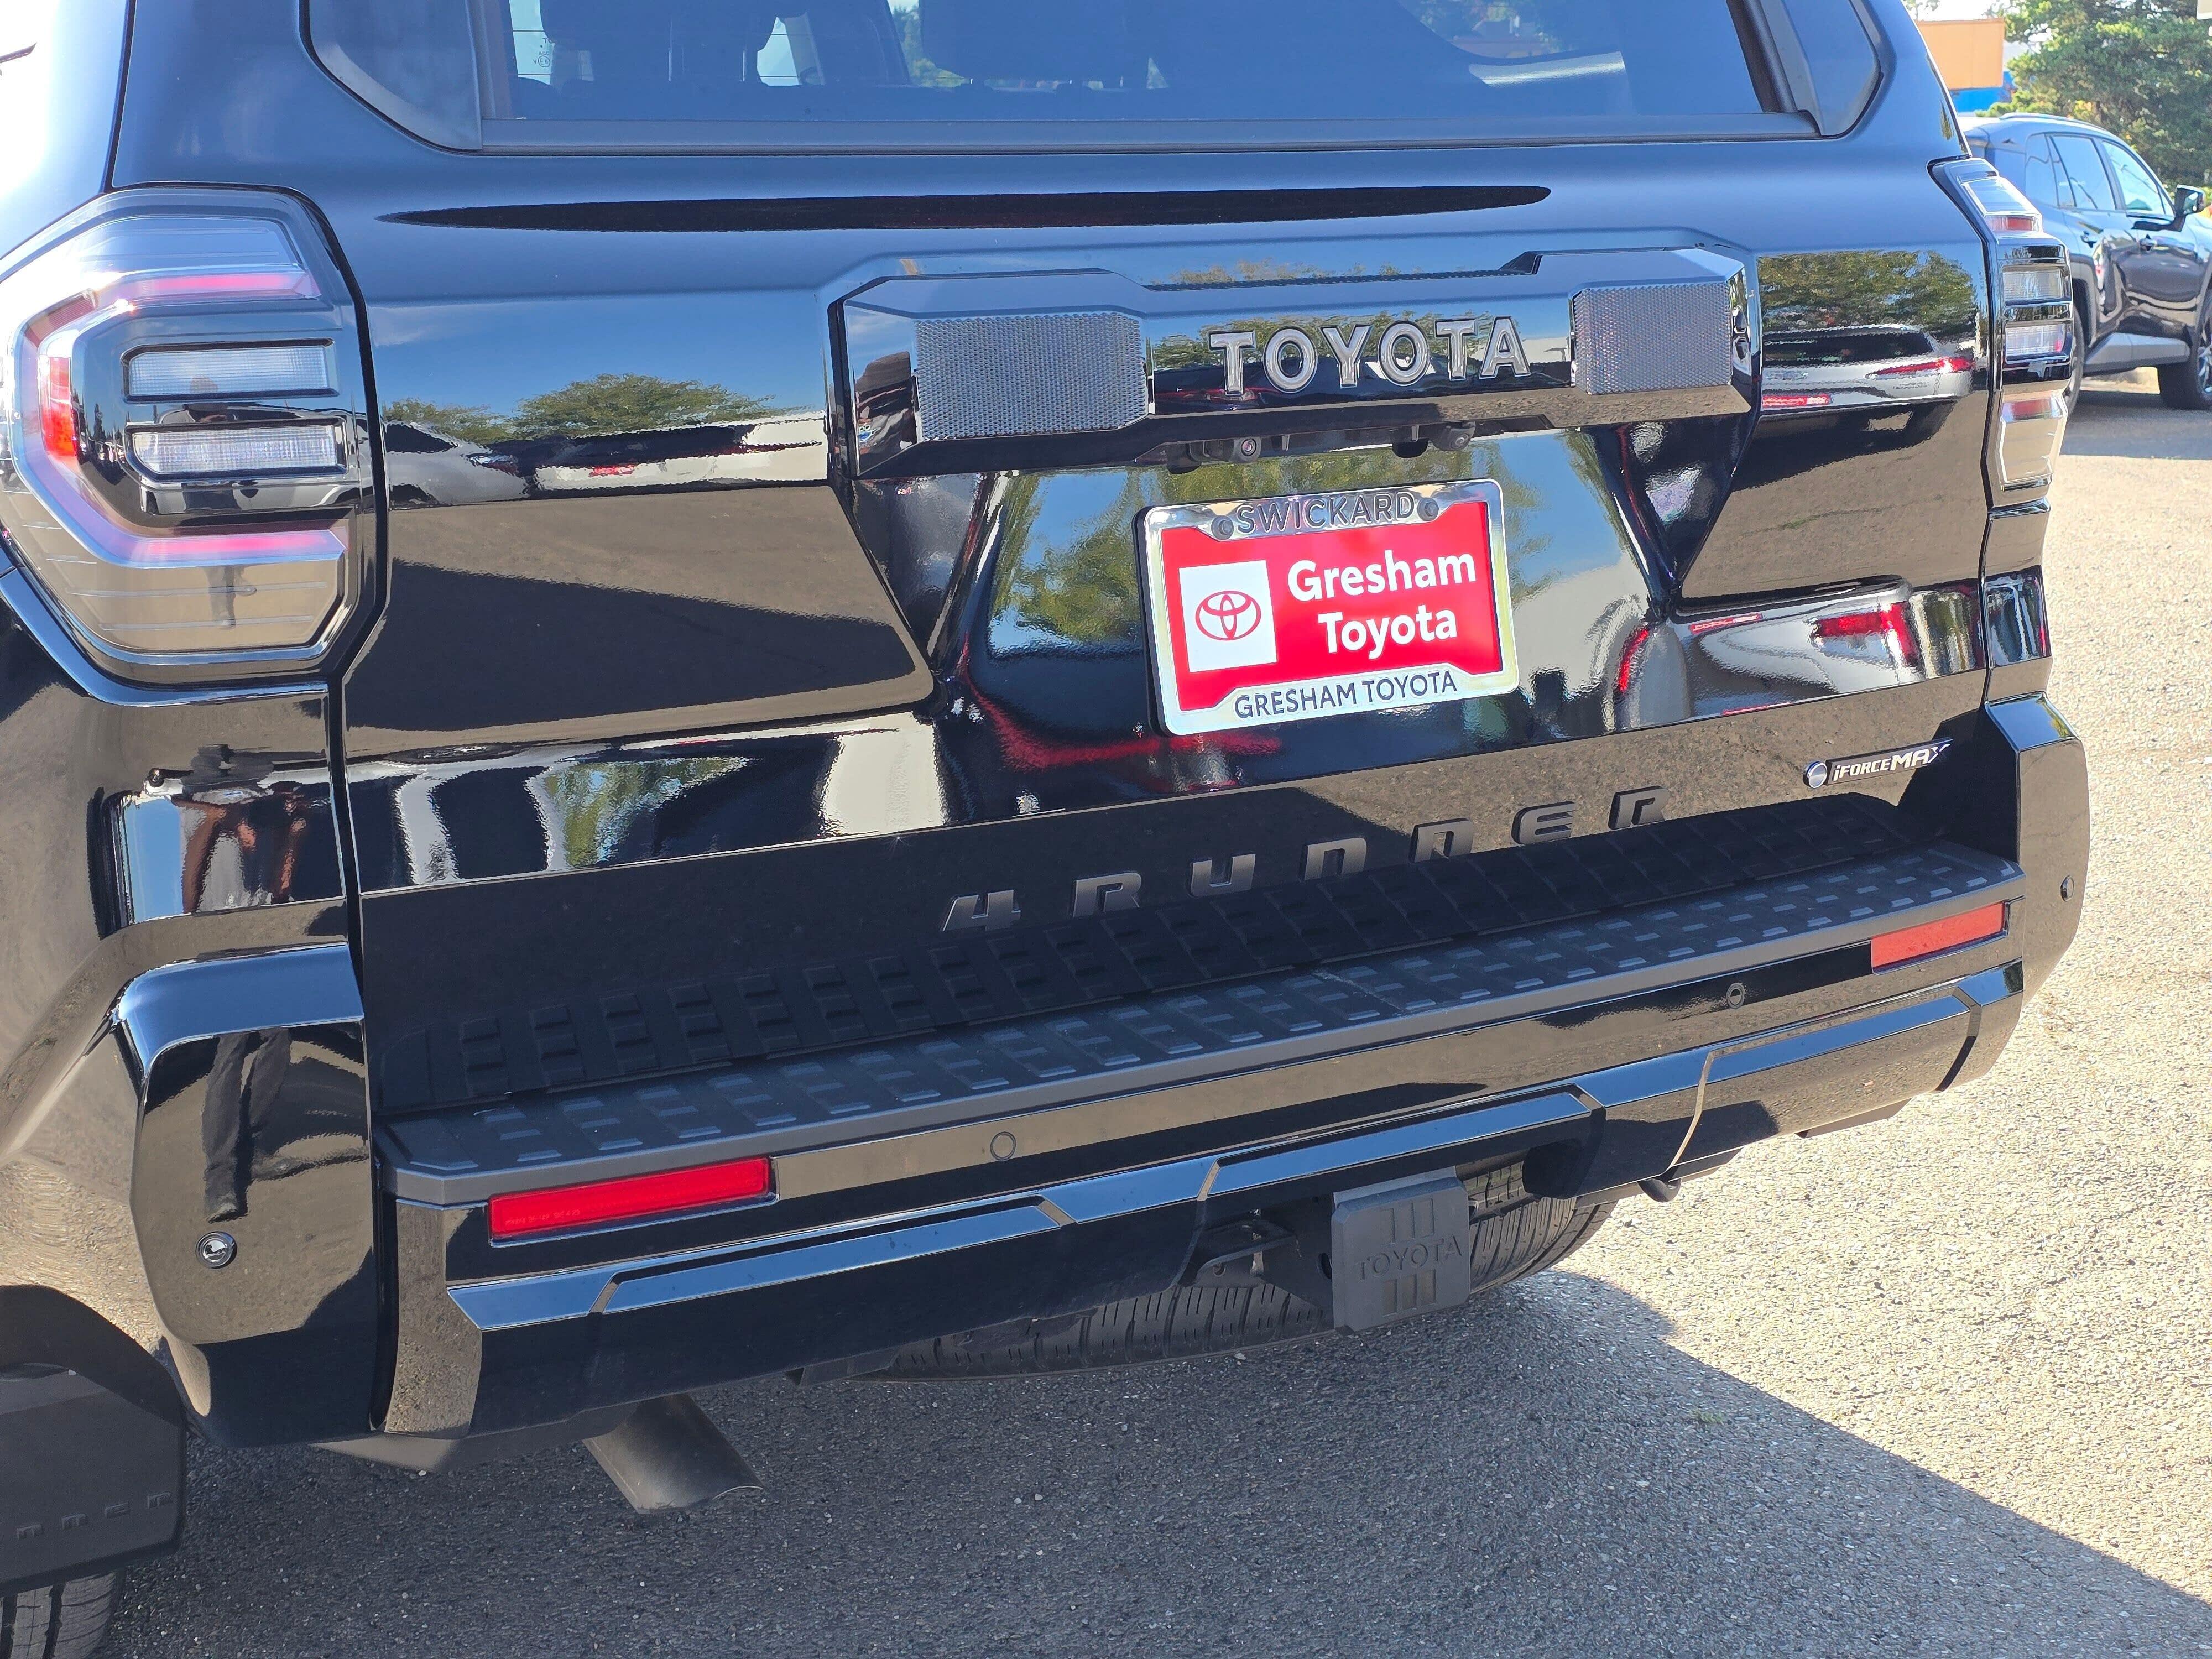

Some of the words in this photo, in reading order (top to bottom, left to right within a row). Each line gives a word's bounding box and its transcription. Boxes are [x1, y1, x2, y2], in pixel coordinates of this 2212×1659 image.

[1208, 316, 1531, 396] TOYOTA
[1236, 492, 1415, 534] SWICKARD
[1287, 549, 1477, 602] Gresham
[1318, 604, 1458, 659] Toyota
[1234, 681, 1357, 719] GRESHAM
[1362, 670, 1458, 707] TOYOTA
[942, 786, 1669, 932] 4RUNNER
[1355, 1235, 1463, 1280] TOYOTA
